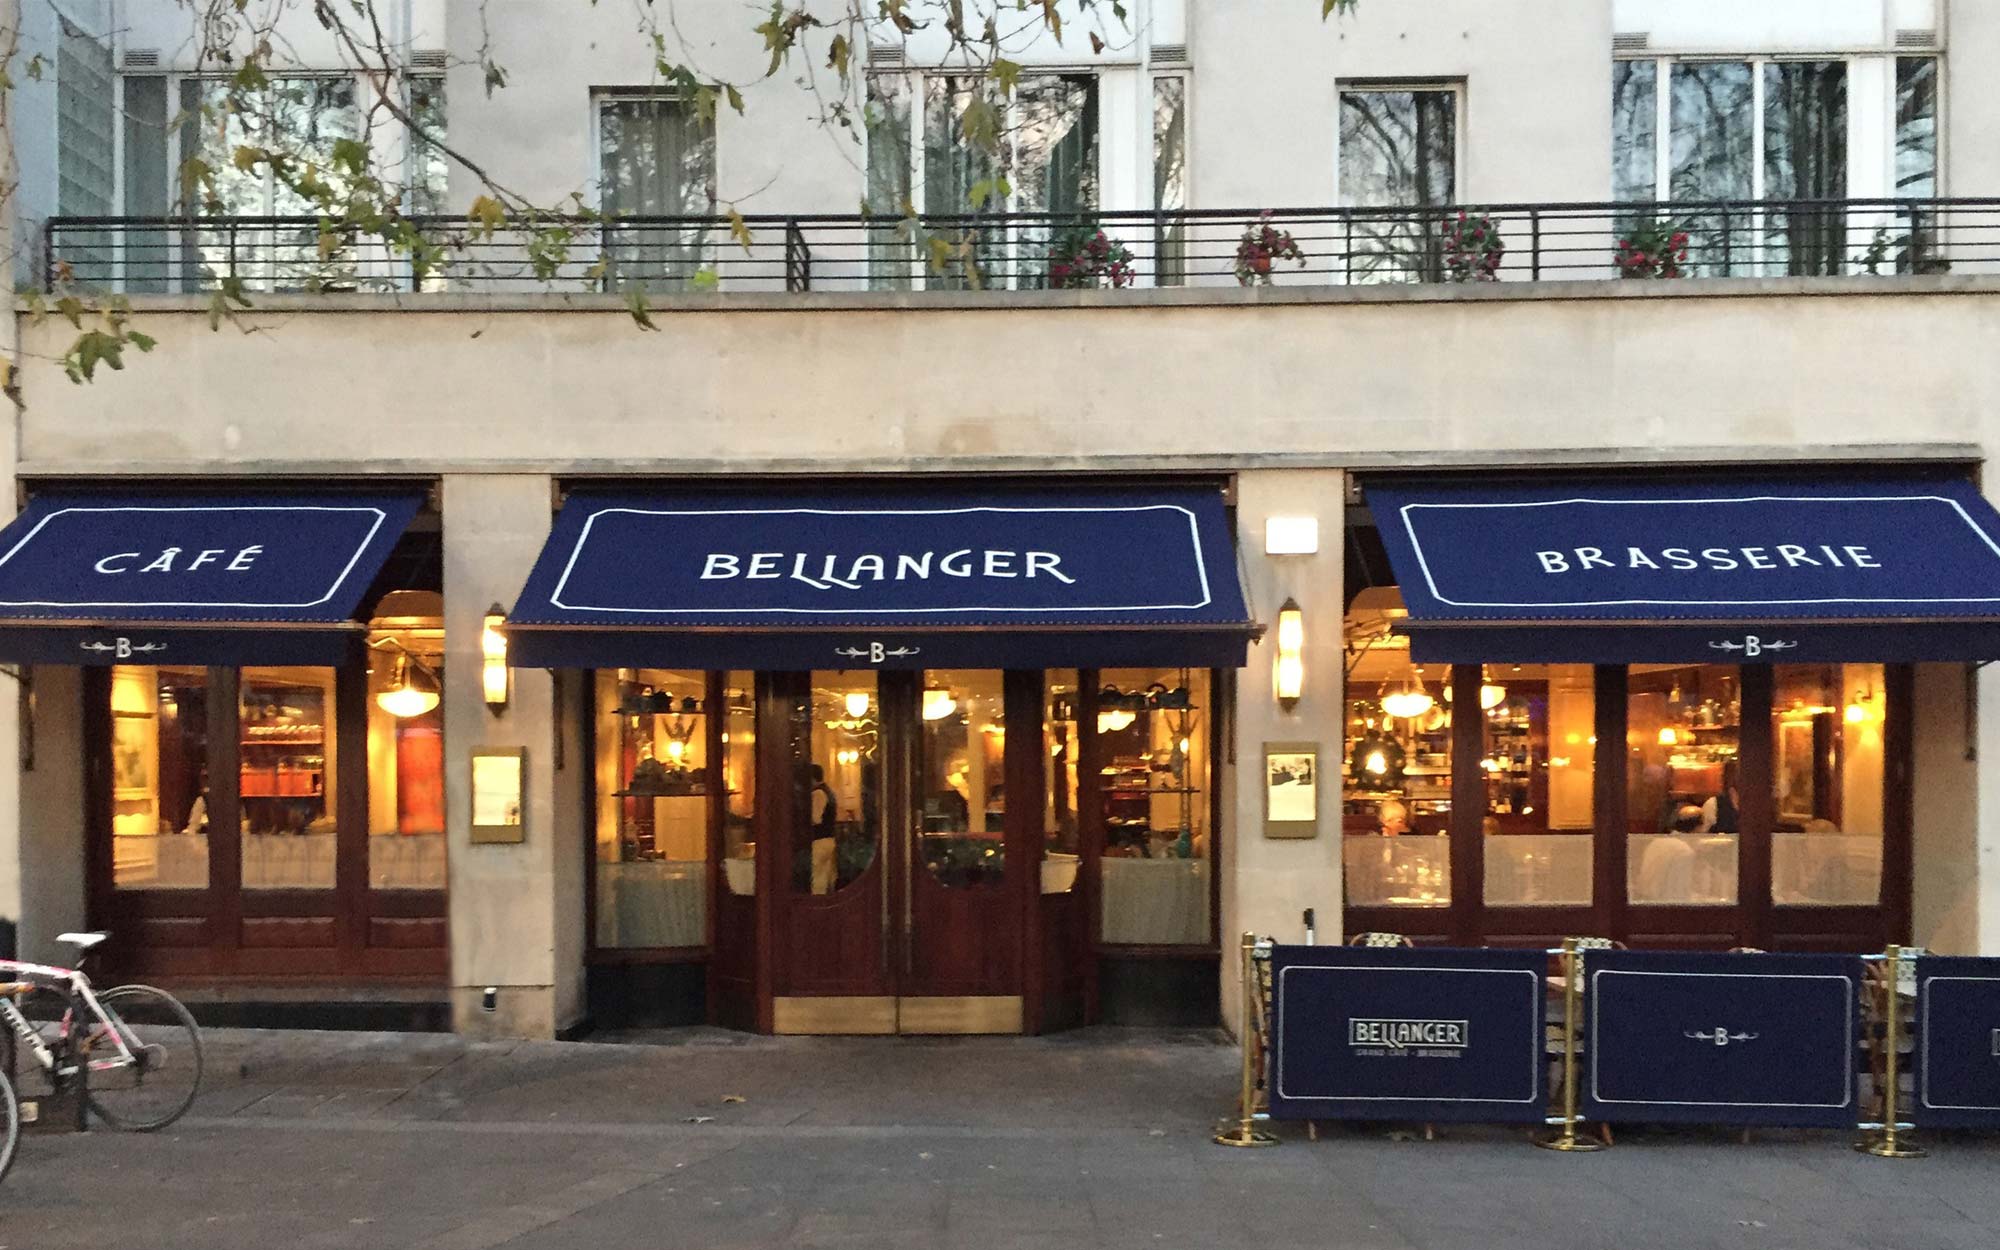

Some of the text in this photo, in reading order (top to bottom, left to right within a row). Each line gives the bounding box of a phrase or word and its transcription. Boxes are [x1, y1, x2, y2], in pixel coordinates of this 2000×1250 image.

[700, 549, 1075, 590] BELLANGER
[1535, 544, 1882, 574] BRASSERIE
[115, 637, 132, 658] B
[870, 641, 885, 663] B
[1745, 635, 1761, 656] B
[1356, 1022, 1461, 1048] BELLANGER
[1715, 1027, 1729, 1046] B
